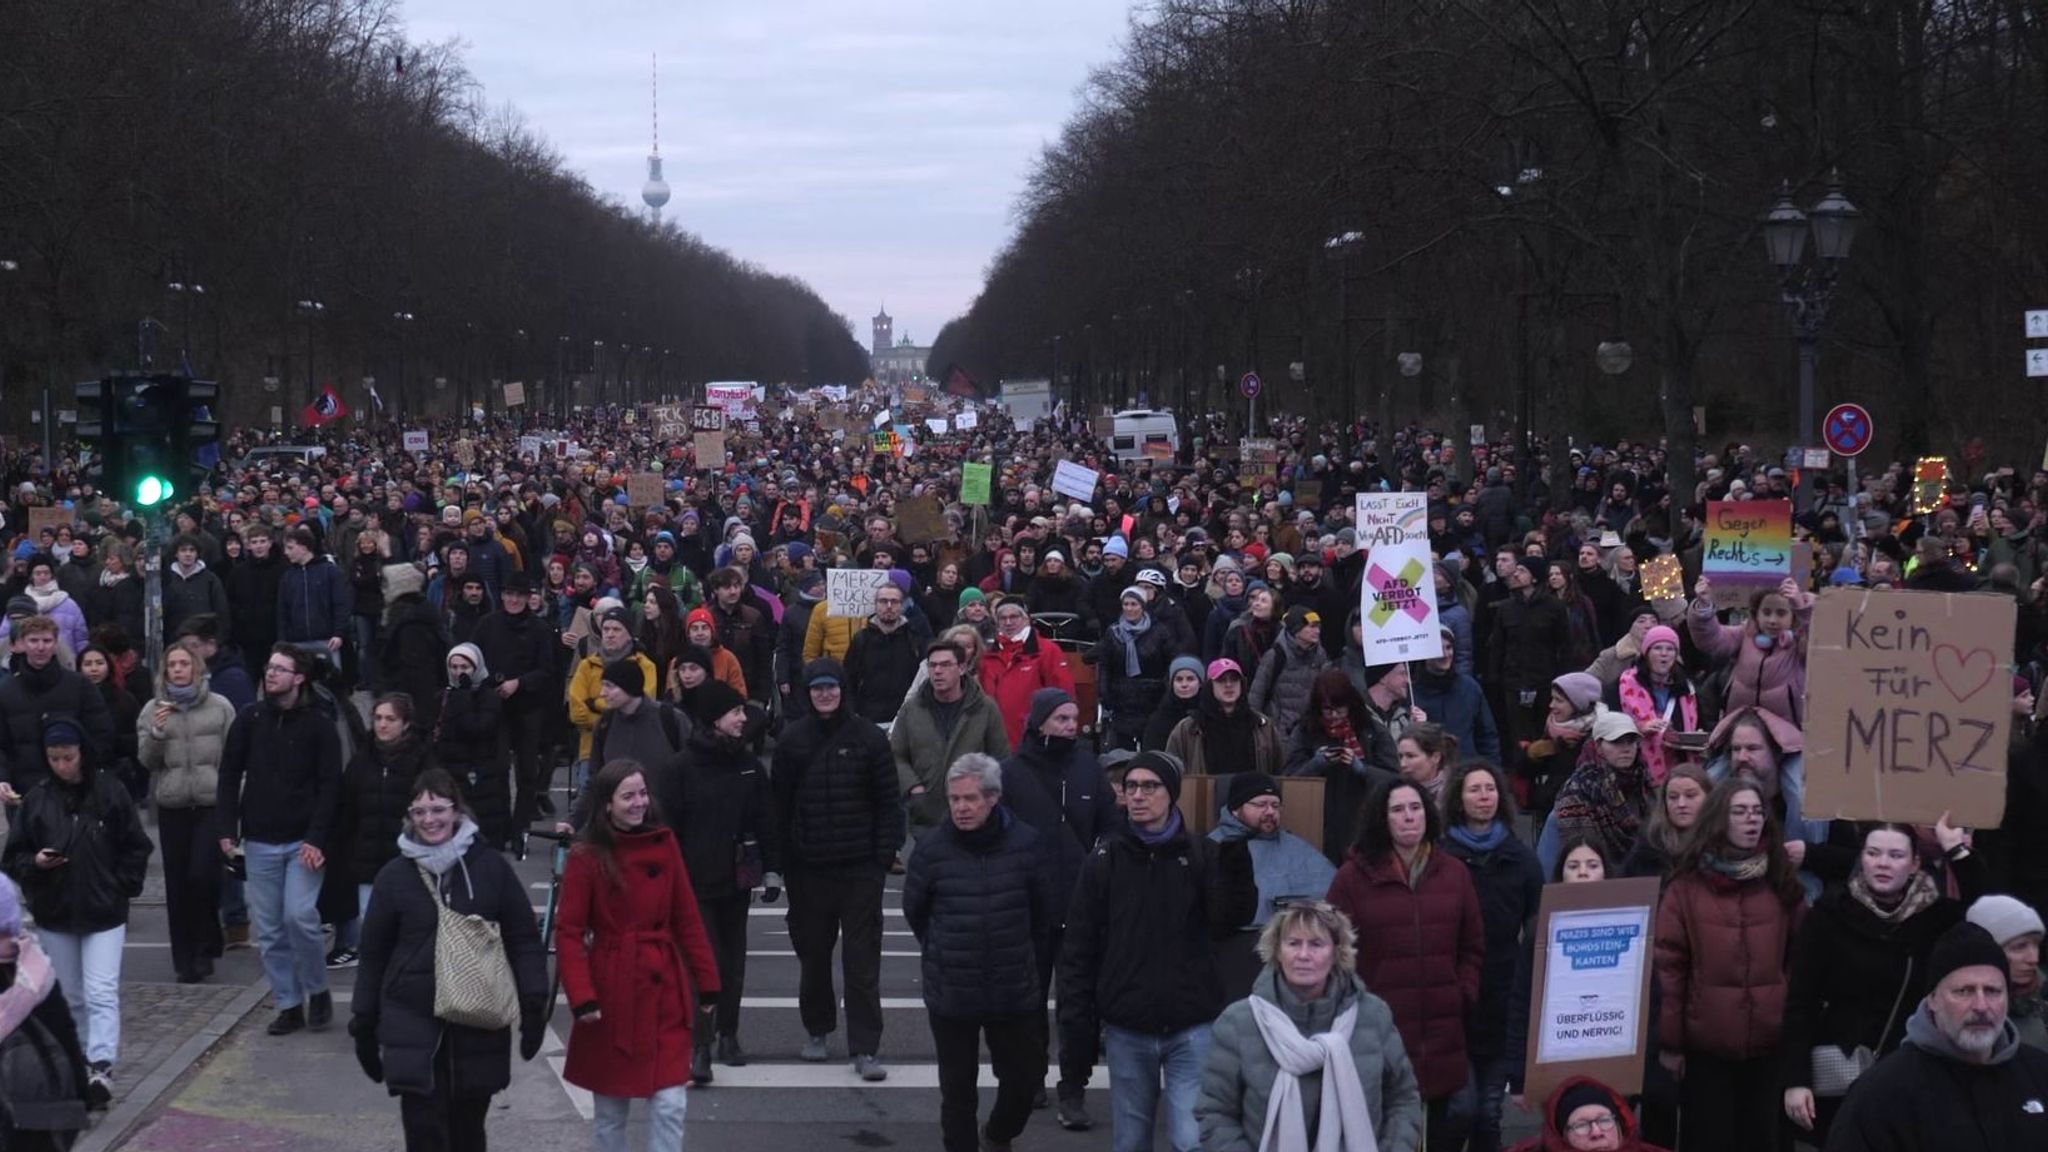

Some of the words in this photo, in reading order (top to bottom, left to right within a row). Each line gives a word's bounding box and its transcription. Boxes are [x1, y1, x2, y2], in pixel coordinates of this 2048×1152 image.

[658, 423, 686, 437] AFD
[1360, 498, 1391, 510] LASST
[1718, 508, 1767, 538] Gegen
[833, 571, 884, 589] MERZ
[1383, 578, 1409, 590] AFD
[1372, 587, 1422, 602] VERBOT
[1380, 598, 1417, 612] JETZT
[1844, 609, 1931, 651] Kein
[1863, 666, 1931, 699] Für
[1844, 708, 1996, 777] MERZ
[1559, 929, 1589, 941] NAZIS
[1591, 927, 1615, 938] SIND
[1616, 926, 1637, 936] WIE
[1567, 939, 1627, 953] BORDSTEIN-
[1575, 954, 1615, 968] KANTEN
[1556, 1010, 1625, 1025] ÜBERFLÜSSIG
[1556, 1028, 1579, 1040] UND
[1582, 1025, 1623, 1038] NERVIG!
